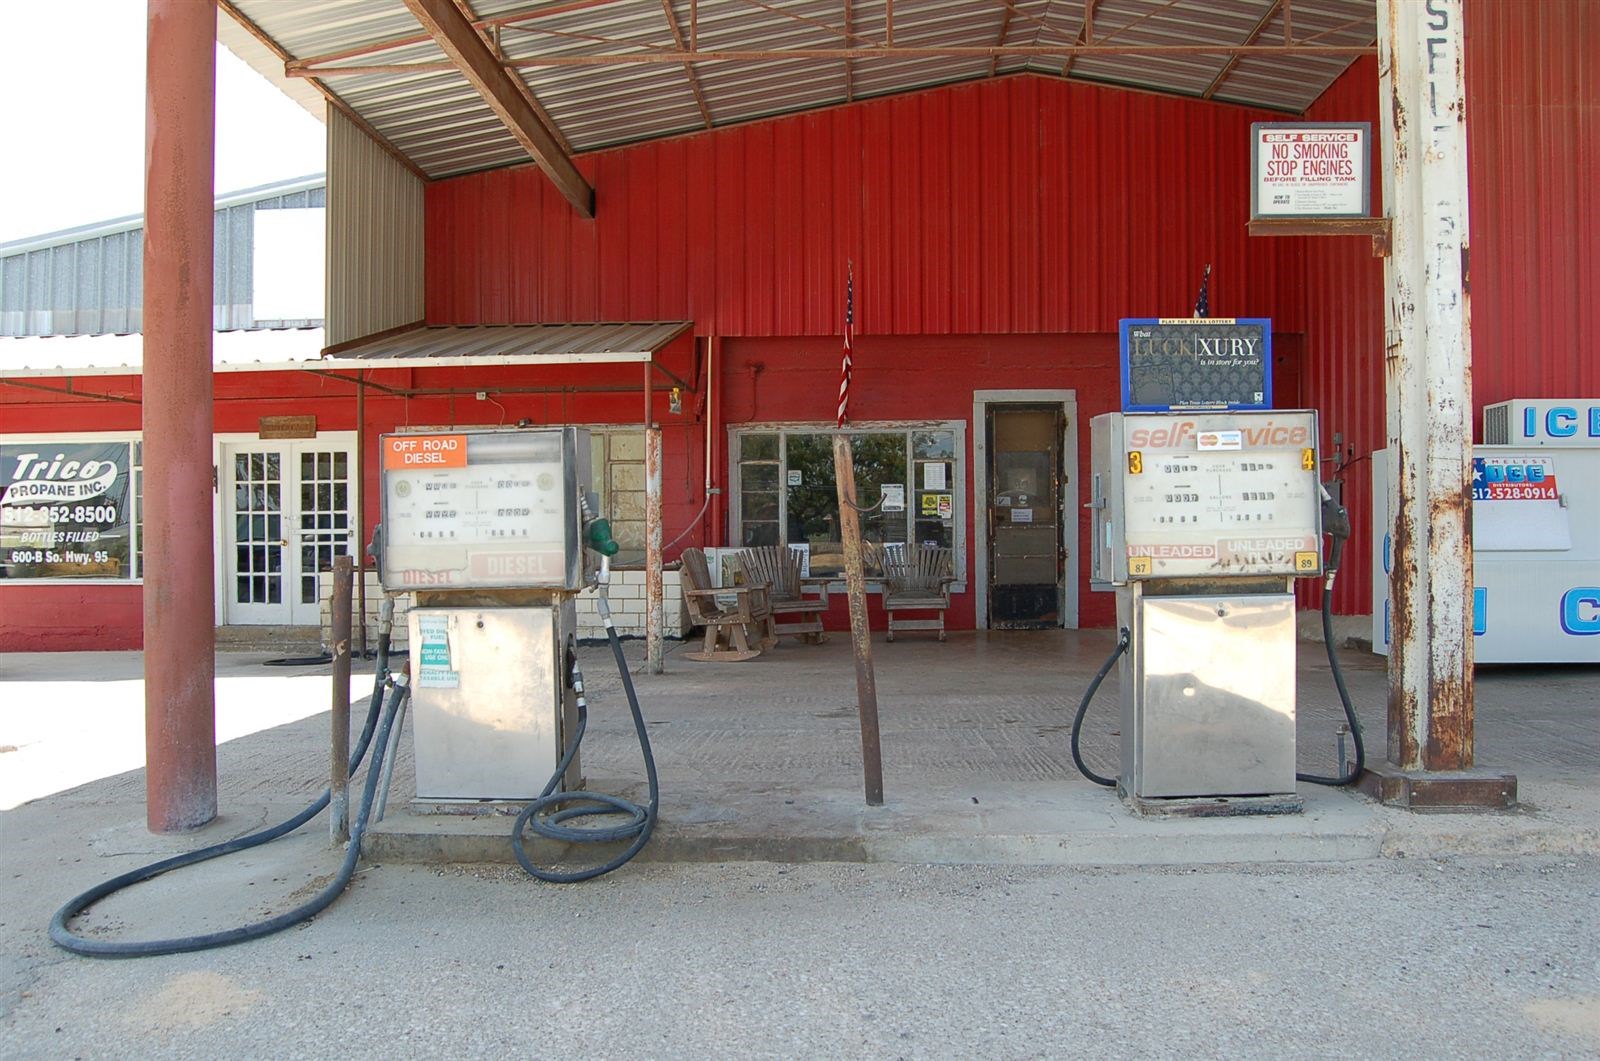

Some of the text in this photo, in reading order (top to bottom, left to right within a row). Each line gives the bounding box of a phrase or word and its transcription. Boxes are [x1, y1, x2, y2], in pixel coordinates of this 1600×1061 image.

[1266, 133, 1355, 142] SELF SERVICE
[1272, 143, 1348, 160] NO SMOKING
[1267, 160, 1353, 176] STOP ENGINES
[1133, 330, 1152, 338] What
[1231, 358, 1243, 367] for
[1242, 358, 1260, 368] you?
[393, 440, 457, 452] OFF ROAD
[404, 453, 447, 464] DIESEL
[1130, 452, 1143, 474] 3
[1303, 450, 1314, 470] 4
[12, 453, 100, 480] Trico
[1490, 466, 1542, 480] ICE
[10, 481, 107, 498] PROPANE INC.
[1472, 487, 1555, 500] 512-528-0914
[3, 505, 117, 523] 512-352-8500
[21, 531, 100, 543] BOTTLES FILLED
[1128, 545, 1214, 557] UNLEADED
[1227, 539, 1305, 551] UNLEADED
[45, 550, 63, 563] So.
[65, 550, 92, 565] Hwy.
[94, 550, 109, 562] 95
[1300, 559, 1312, 568] 89
[486, 555, 548, 576] DIESEL
[1135, 563, 1147, 573] 87
[402, 570, 454, 585] DIESEL
